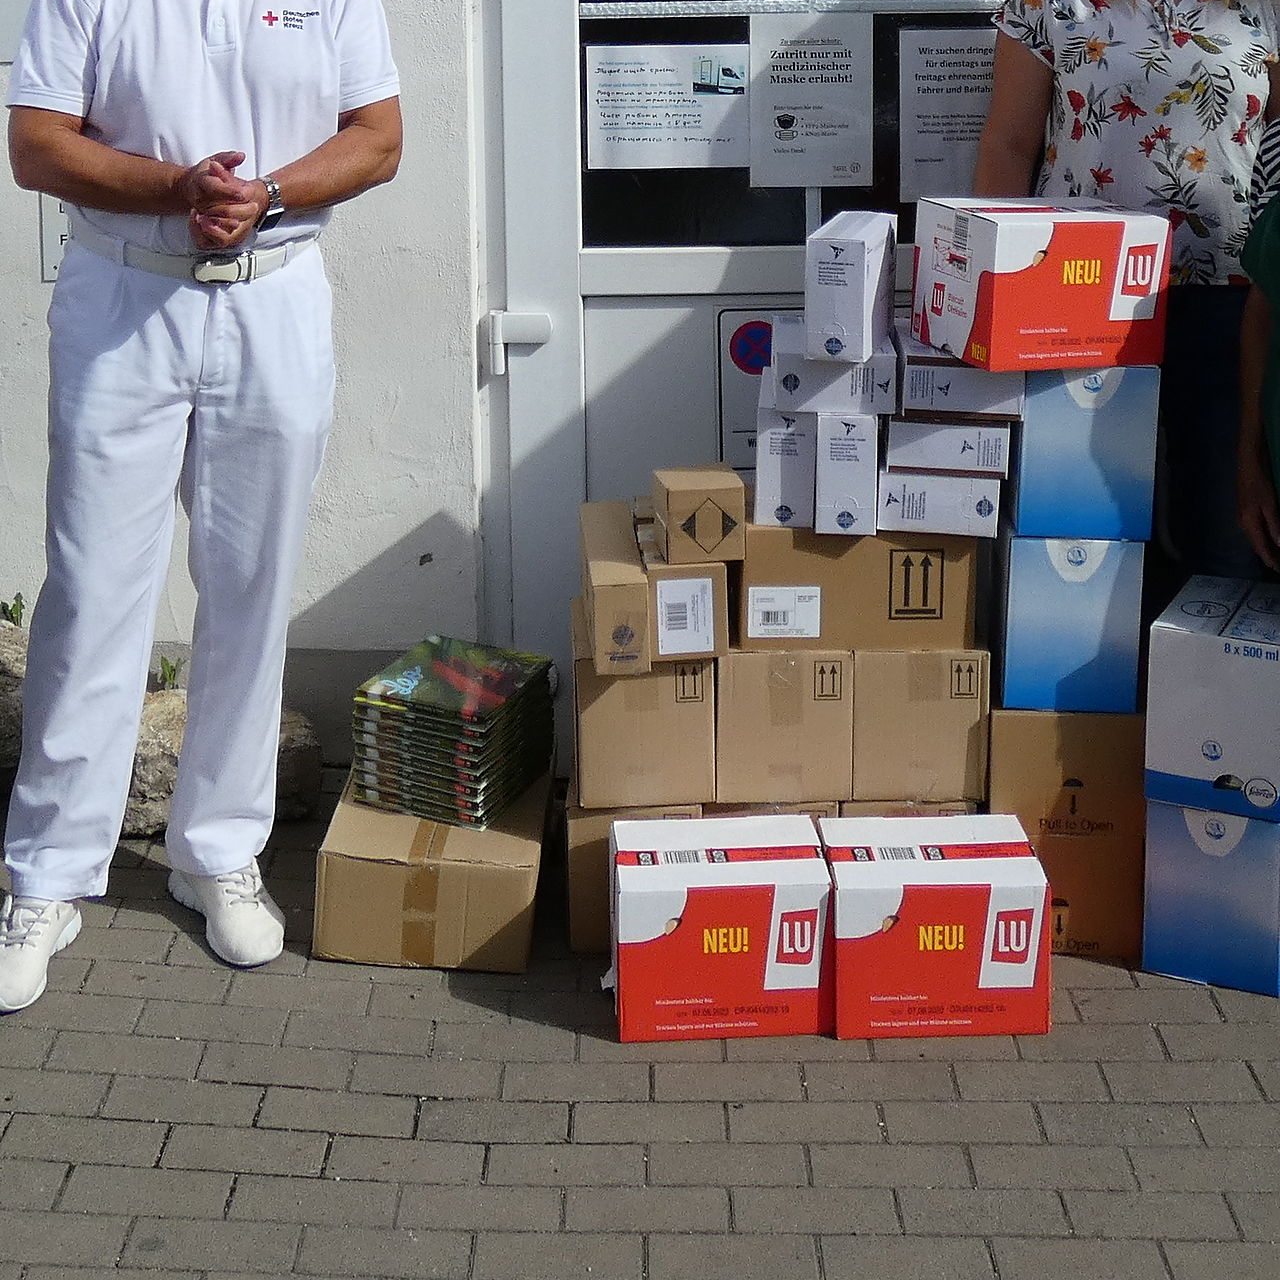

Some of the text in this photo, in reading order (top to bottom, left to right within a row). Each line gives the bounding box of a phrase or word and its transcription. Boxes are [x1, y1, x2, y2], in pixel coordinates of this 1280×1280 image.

[770, 49, 853, 59] Zutritt nur mit
[918, 47, 934, 55] Wir
[935, 47, 965, 55] suchen
[771, 61, 852, 72] medizinischer
[925, 60, 938, 68] für
[940, 60, 979, 69] dienstags
[769, 73, 853, 84] Maske erlaubt!
[915, 73, 946, 82] freitags
[917, 86, 944, 94] Fahrer
[945, 85, 962, 94] und
[1062, 255, 1152, 287] NEU! LU
[1224, 642, 1279, 662] 8 x 500 ml
[1039, 818, 1114, 833] Pull to Open
[702, 920, 812, 955] NEU! LU
[918, 919, 1028, 953] NEU! LU
[1070, 939, 1100, 952] Open
